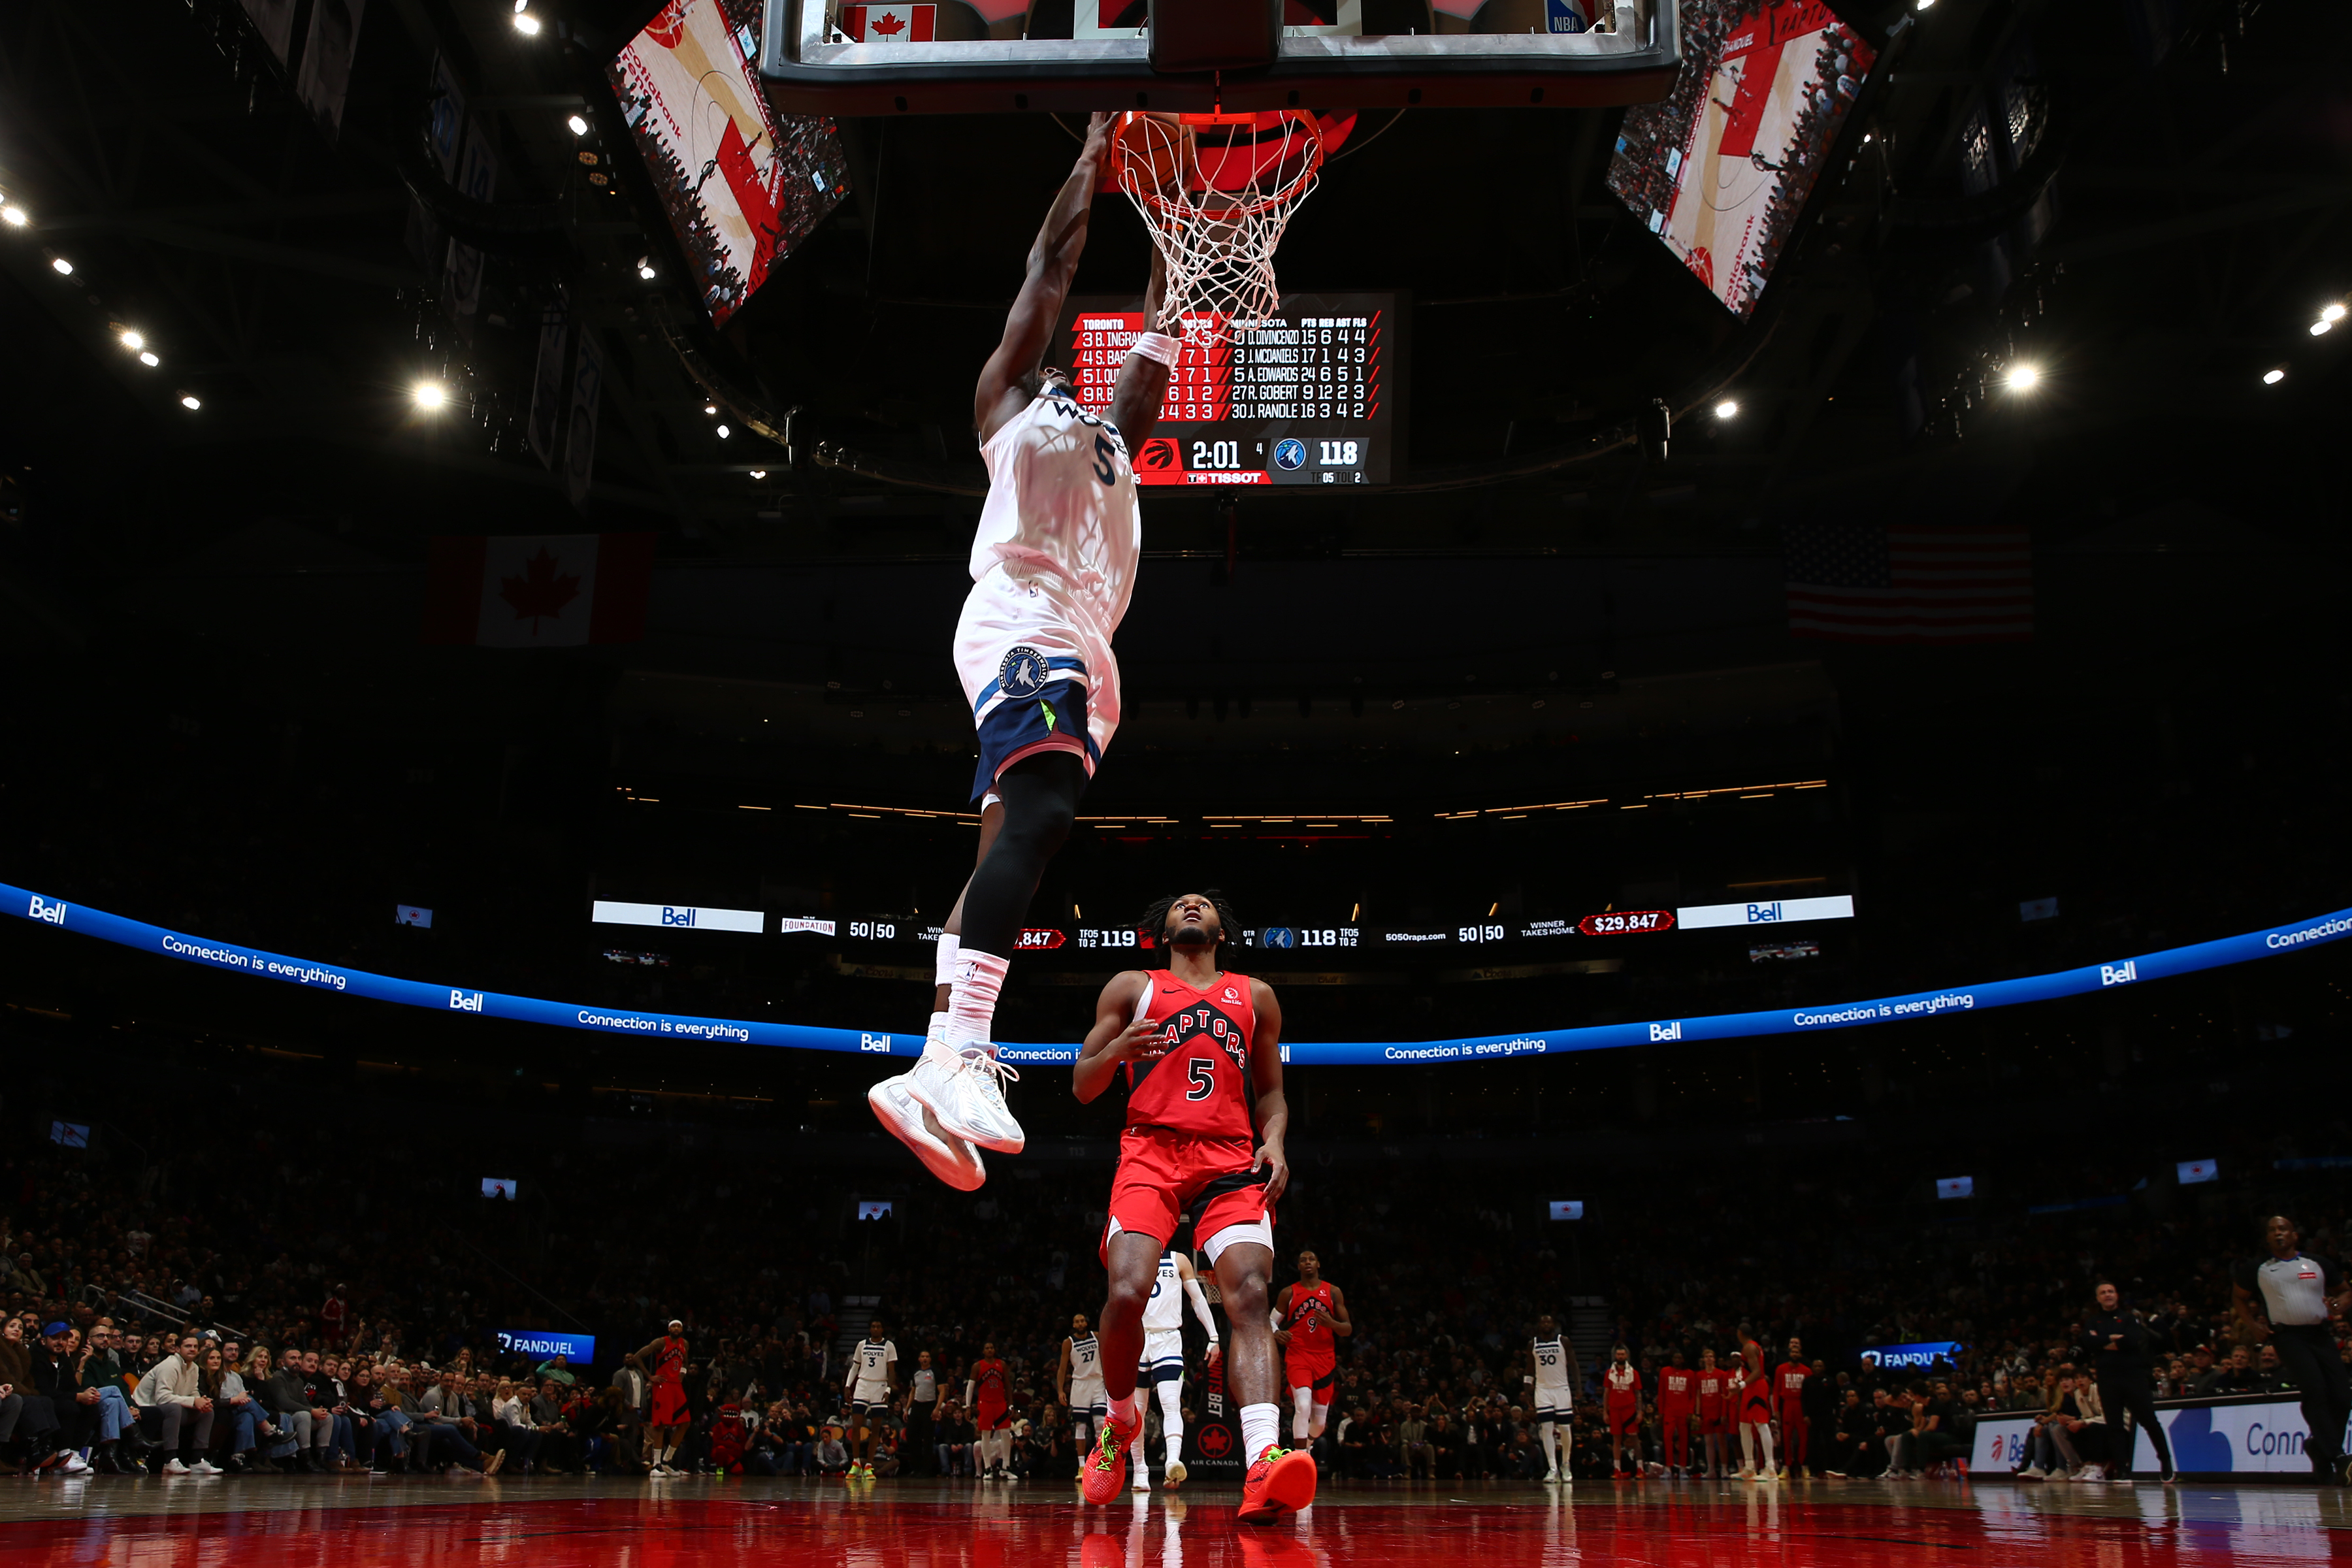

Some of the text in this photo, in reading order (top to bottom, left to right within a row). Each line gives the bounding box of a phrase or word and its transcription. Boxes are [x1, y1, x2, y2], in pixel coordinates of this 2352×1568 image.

[1554, 17, 1578, 31] NBA
[1083, 319, 1124, 330] TORONTO
[1301, 318, 1316, 327] PTS
[1319, 318, 1334, 327] REB
[1336, 318, 1351, 327] AST
[1353, 318, 1367, 327] FLS
[1083, 332, 1093, 347] 3
[1096, 332, 1105, 347] B.
[1185, 332, 1196, 346] 4
[1201, 331, 1212, 346] 3
[1235, 329, 1365, 345] 0 D. DIVINCENZO 15 6 4 4
[1083, 350, 1093, 365] 4
[1096, 350, 1105, 365] S.
[1107, 350, 1130, 365] BAR
[1186, 350, 1195, 364] 7
[1203, 350, 1211, 364] 1
[1234, 348, 1365, 364] 3 J. MCDANIELS 17 1 4 3
[1083, 368, 1093, 384] 5
[1096, 368, 1103, 384] I.
[1186, 368, 1196, 382] 7
[1203, 368, 1211, 382] 1
[1234, 367, 1364, 382] 5 A. EDWARDS 24 6 5 1
[1083, 386, 1213, 402] 9 R. 6 1 2
[1232, 384, 1364, 400] 27 R. GOBERT 9 12 2 3
[1168, 404, 1179, 419] 4
[1186, 404, 1196, 419] 3
[1201, 404, 1213, 419] 3
[1232, 403, 1364, 419] 30 J. RANDLE 16 3 4 2
[1192, 441, 1241, 469] 2:01
[1256, 442, 1263, 455] 4
[1320, 441, 1358, 465] 118
[1092, 433, 1116, 486] 5
[1208, 473, 1262, 483] TISSOT
[1311, 472, 1362, 483] TF 05 TOL 2
[1000, 647, 1047, 688] MINNESOTA TIMBERWOLVES
[29, 895, 67, 925] Bell
[661, 907, 696, 927] Bell
[1747, 903, 1781, 923] Bell
[785, 920, 833, 933] FOUNDATION
[1530, 920, 1565, 929] WINNER
[1594, 913, 1659, 933] $29,847
[1101, 930, 1135, 947] 119
[1301, 930, 1336, 946] 118
[1385, 932, 1446, 942] 5050raps.com
[1521, 926, 1575, 937] TAKES HOME
[2266, 917, 2352, 949] Connection
[1015, 932, 1051, 948] ,847
[1079, 939, 1088, 947] TO
[1339, 938, 1357, 947] TO 2
[162, 935, 346, 990] Connection is everything
[2100, 960, 2136, 987] Bell
[449, 989, 483, 1013] Bell
[1793, 992, 1974, 1027] Connection is everything
[578, 1010, 749, 1041] Connection is everything
[1649, 1021, 1681, 1041] Bell
[861, 1033, 891, 1053] Bell
[1384, 1037, 1546, 1060] Connection is everything
[998, 1047, 1071, 1061] Connection
[1186, 1057, 1215, 1102] 5
[1295, 1299, 1330, 1320] RAPTOR
[1307, 1317, 1317, 1333] 9
[514, 1339, 576, 1355] FANDUEL
[1076, 1343, 1098, 1352] WOLVES
[868, 1357, 875, 1367] 3
[1081, 1350, 1095, 1363] 27
[1539, 1354, 1556, 1365] 30
[1884, 1352, 1953, 1367] FANDU
[672, 1360, 679, 1371] 3
[988, 1379, 998, 1388] 12
[2247, 1422, 2305, 1456] Conn
[2009, 1439, 2025, 1462] Be
